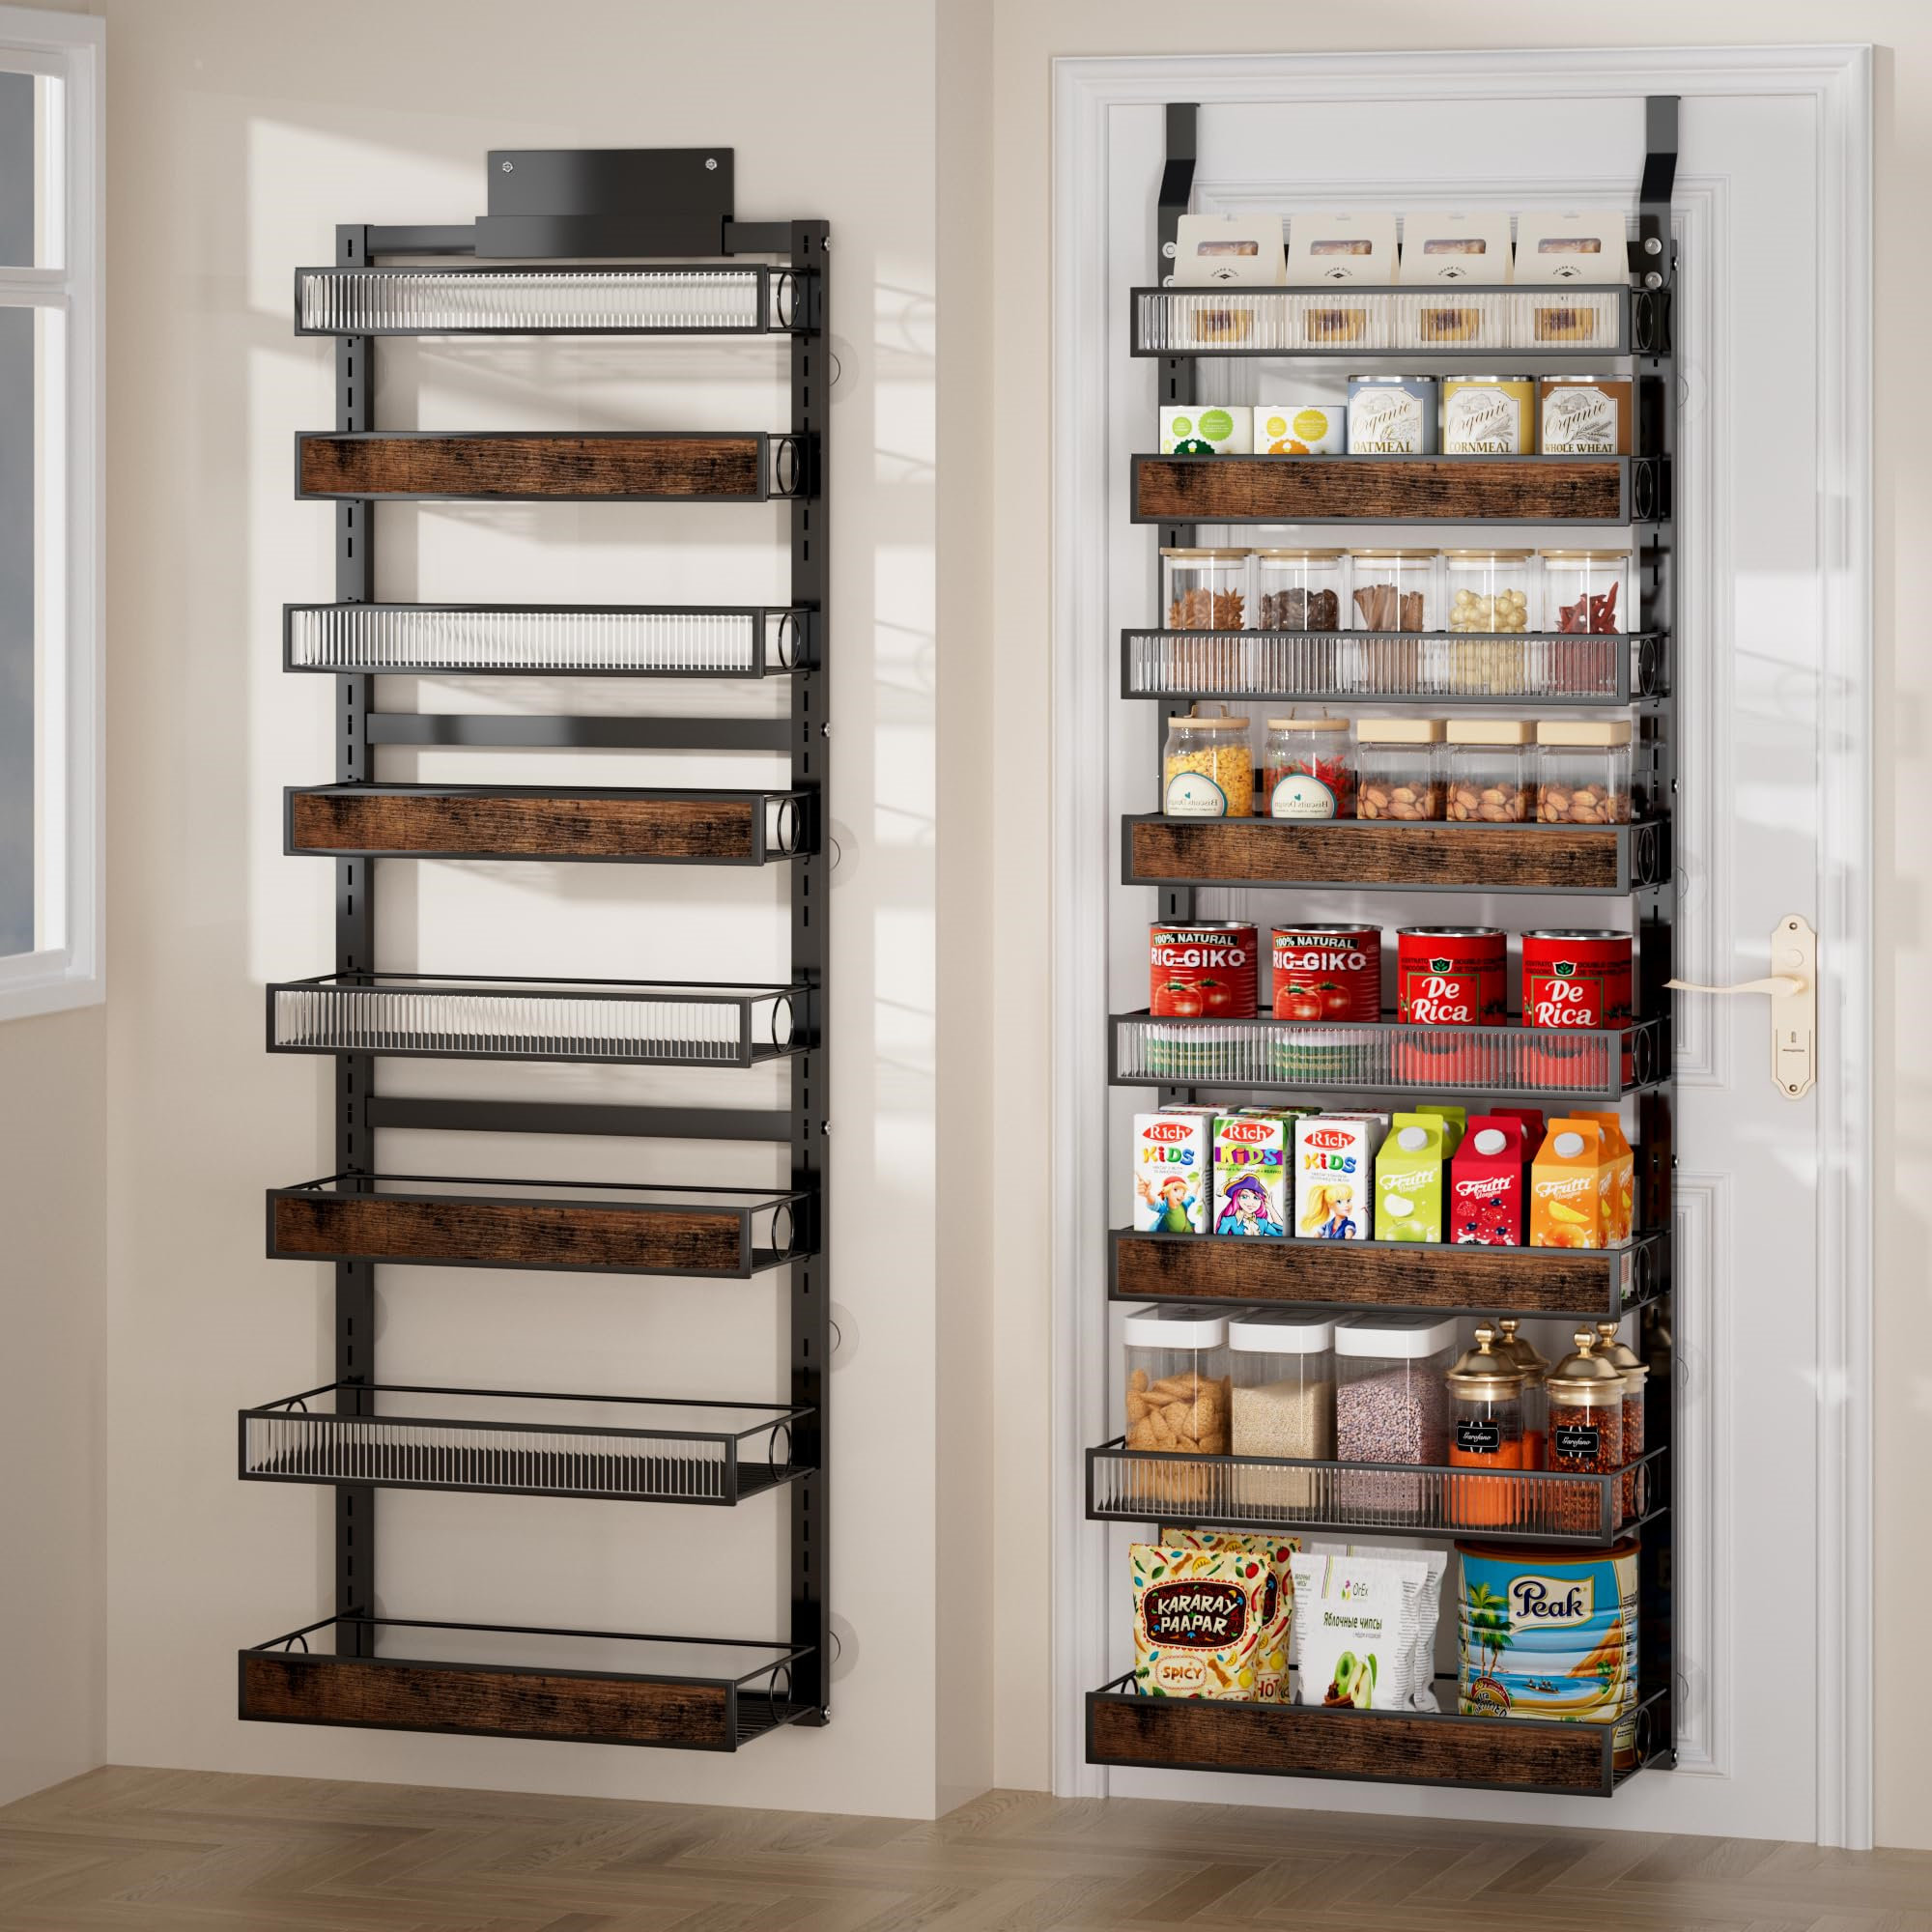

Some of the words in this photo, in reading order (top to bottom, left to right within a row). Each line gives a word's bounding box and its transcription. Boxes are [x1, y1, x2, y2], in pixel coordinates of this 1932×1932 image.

[1352, 400, 1410, 438] Organic
[1449, 400, 1508, 438] Organic
[1546, 400, 1606, 439] Organic
[1353, 441, 1413, 453] OATMEAL
[1449, 441, 1512, 453] CORNMEAL
[1546, 443, 1574, 453] WHOLE
[1577, 443, 1613, 453] WHEAT
[1154, 934, 1175, 944] 100%
[1179, 933, 1235, 946] NATURAL
[1276, 937, 1294, 947] 100%
[1297, 936, 1354, 949] NATURAL
[1421, 977, 1460, 999] De
[1546, 980, 1584, 1003] De
[1411, 999, 1474, 1024] Rica
[1535, 1002, 1598, 1028] Rica
[1149, 1124, 1187, 1141] Rich
[1228, 1123, 1268, 1142] Rich
[1311, 1132, 1349, 1149] Rich
[1379, 1167, 1435, 1191] Frutti
[1455, 1176, 1513, 1197] Frutti
[1535, 1177, 1592, 1197] Frutti
[1158, 1594, 1238, 1616] KARARAY
[1513, 1580, 1583, 1618] Peak
[1161, 1615, 1228, 1635] PAAPAR
[1323, 1611, 1357, 1630] Яблочные
[1360, 1616, 1383, 1631] чипсы
[1162, 1666, 1203, 1680] SPICY
